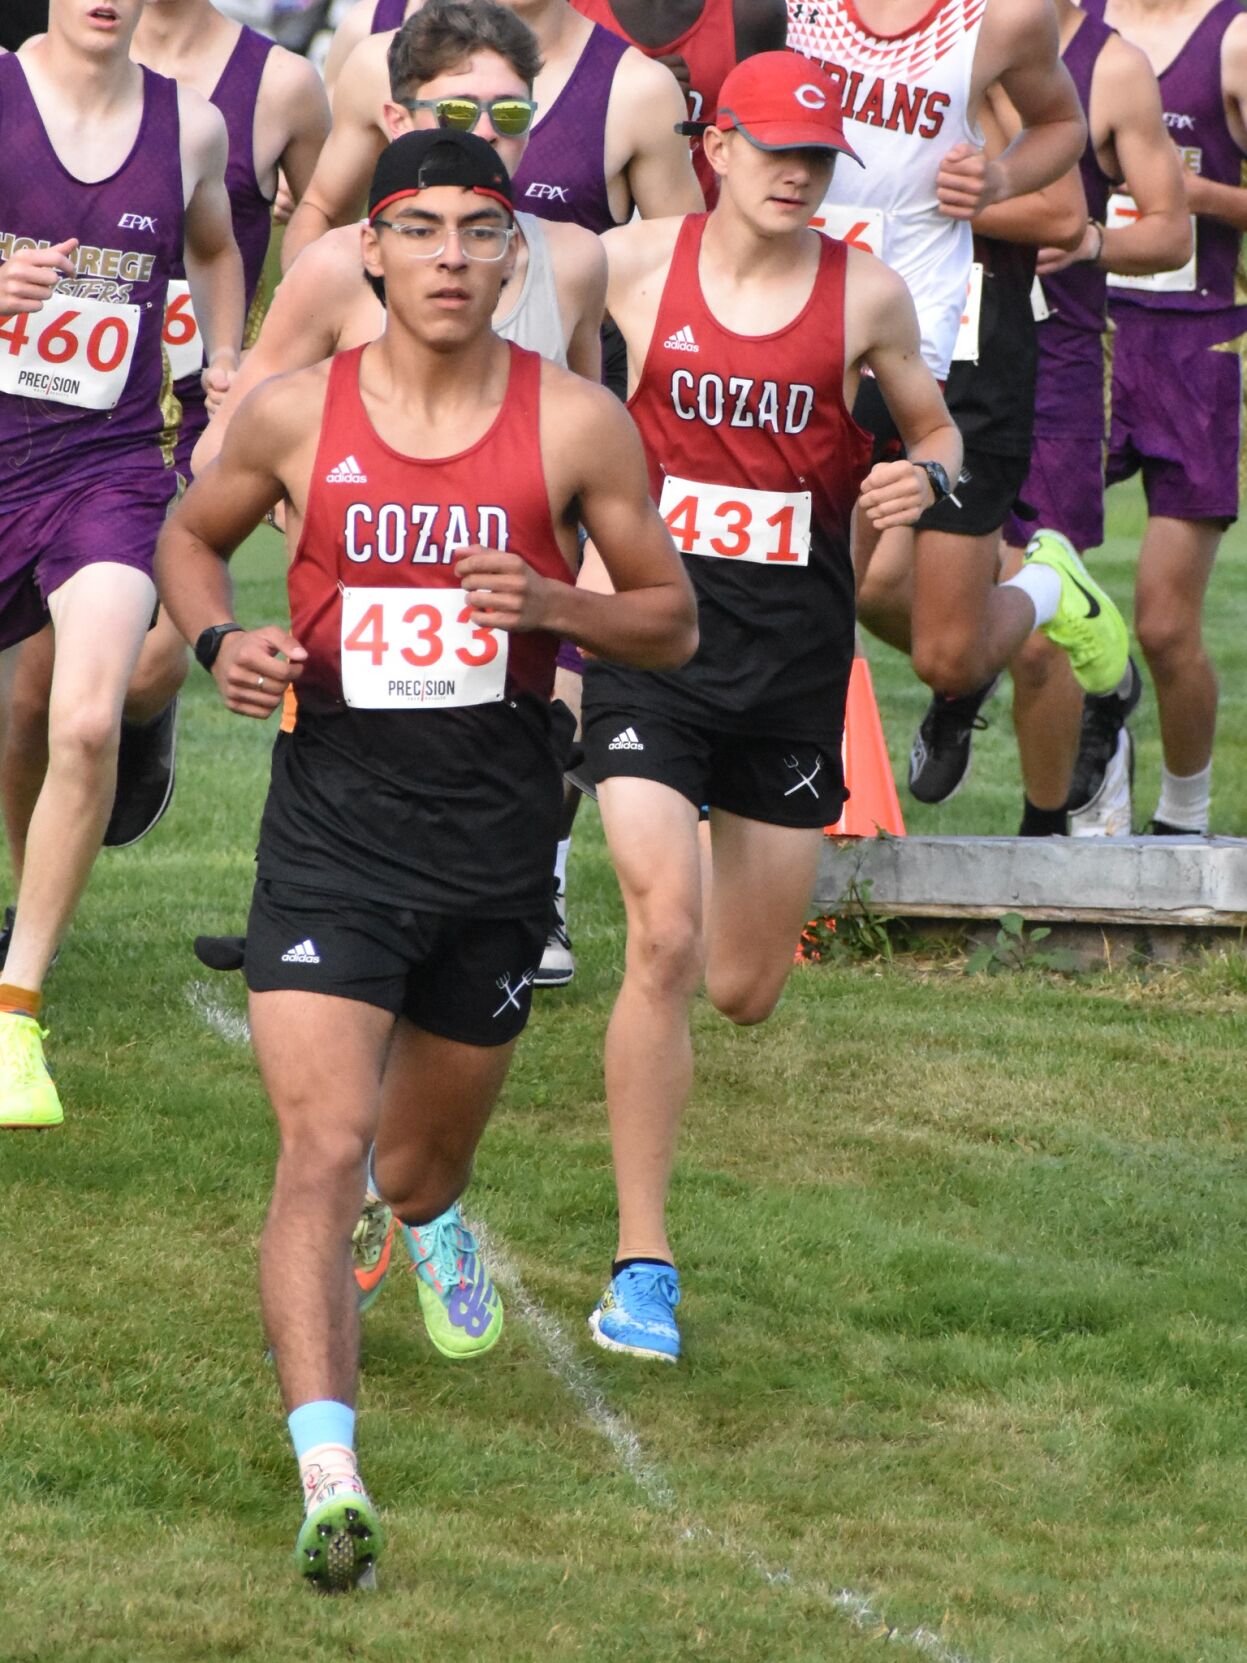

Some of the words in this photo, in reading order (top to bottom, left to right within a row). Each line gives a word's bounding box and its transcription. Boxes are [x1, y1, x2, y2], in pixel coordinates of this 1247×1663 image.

[0, 310, 129, 373] 460
[663, 340, 700, 353] adidas
[670, 368, 815, 434] COZAD
[326, 473, 367, 483] adidas
[344, 502, 509, 565] COZAD
[664, 495, 799, 562] 431
[343, 604, 499, 668] 433
[608, 741, 644, 751] adidas
[281, 953, 320, 964] adidas
